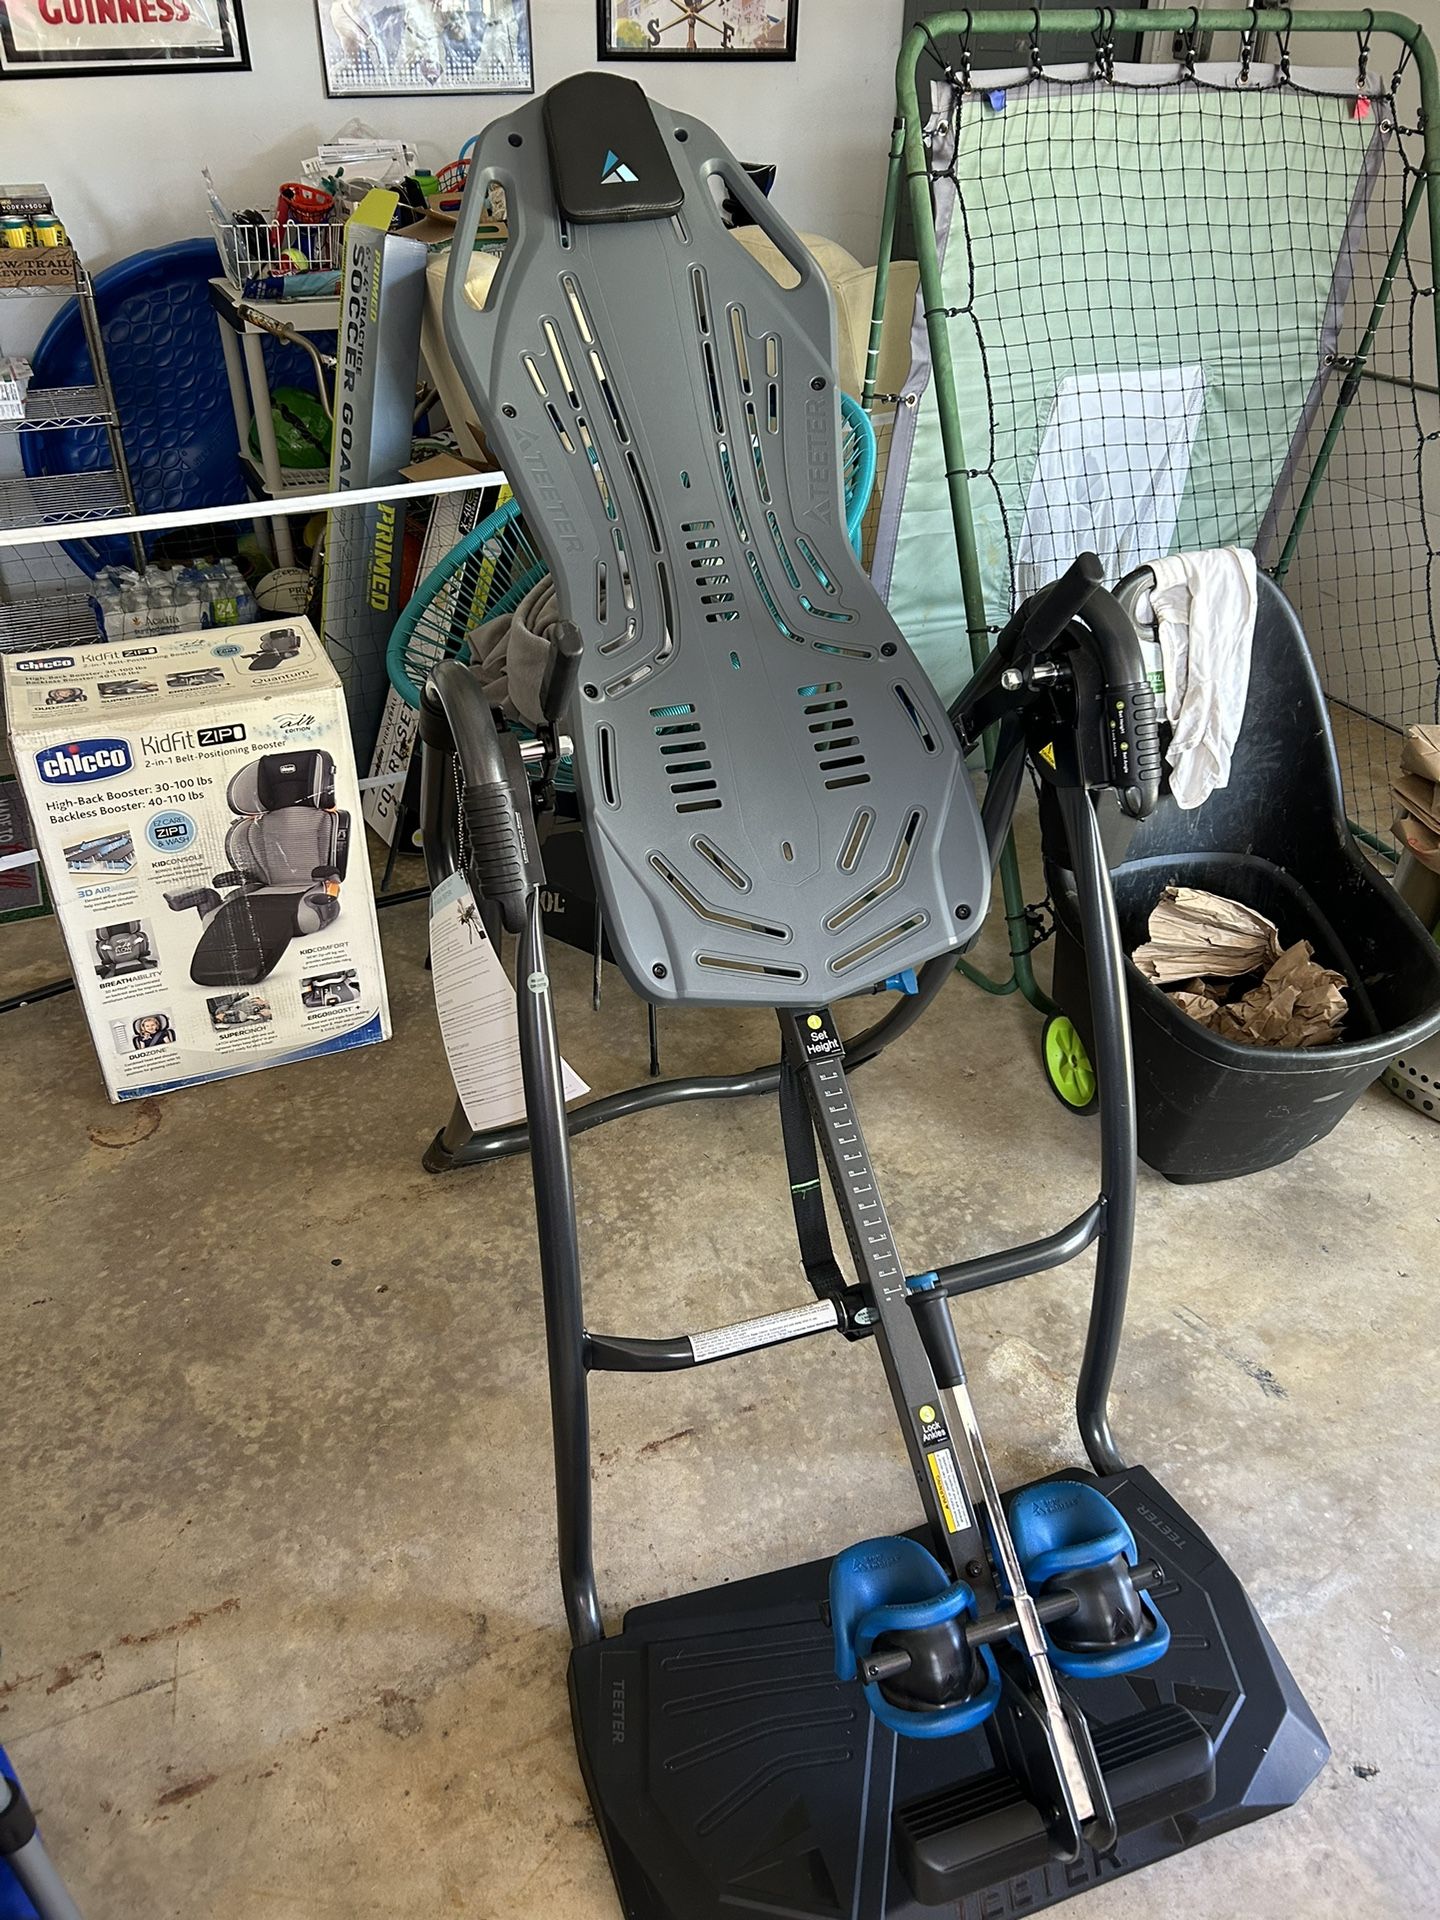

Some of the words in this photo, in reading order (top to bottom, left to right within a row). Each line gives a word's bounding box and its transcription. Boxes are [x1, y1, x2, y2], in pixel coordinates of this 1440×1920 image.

[38, 0, 191, 25] GUINNESS
[648, 18, 661, 46] S
[24, 260, 72, 268] TRAIL
[51, 268, 73, 276] CO.
[343, 243, 365, 393] SOCCER
[805, 396, 831, 502] TEETER
[524, 450, 584, 553] TEETER
[369, 503, 396, 612] PRIMED
[217, 603, 234, 617] 24
[19, 658, 72, 670] chicco
[81, 652, 120, 663] KidFit
[252, 669, 310, 684] Quantum
[285, 726, 312, 734] EDITION
[397, 700, 414, 738] SET
[140, 731, 195, 756] KidFit
[145, 757, 173, 768] 2-in-1
[175, 747, 250, 765] Belt-Positioning
[251, 740, 286, 752] Booster
[43, 744, 127, 778] chicco
[46, 794, 104, 812] High-Back
[106, 786, 153, 802] Booster:
[154, 778, 195, 792] 30-100
[197, 777, 213, 786] lbs
[50, 808, 97, 825] Backless
[100, 800, 146, 815] Booster:
[148, 793, 186, 807] 40-110
[188, 791, 205, 801] lbs
[95, 886, 111, 894] AIR
[99, 971, 163, 989] BREATHABILITY
[806, 1038, 839, 1055] Height
[811, 1030, 829, 1042] Set
[922, 1421, 941, 1433] Lock
[922, 1429, 947, 1442] Ankles
[1136, 1502, 1187, 1551] TEETER
[612, 1680, 625, 1745] TEETER
